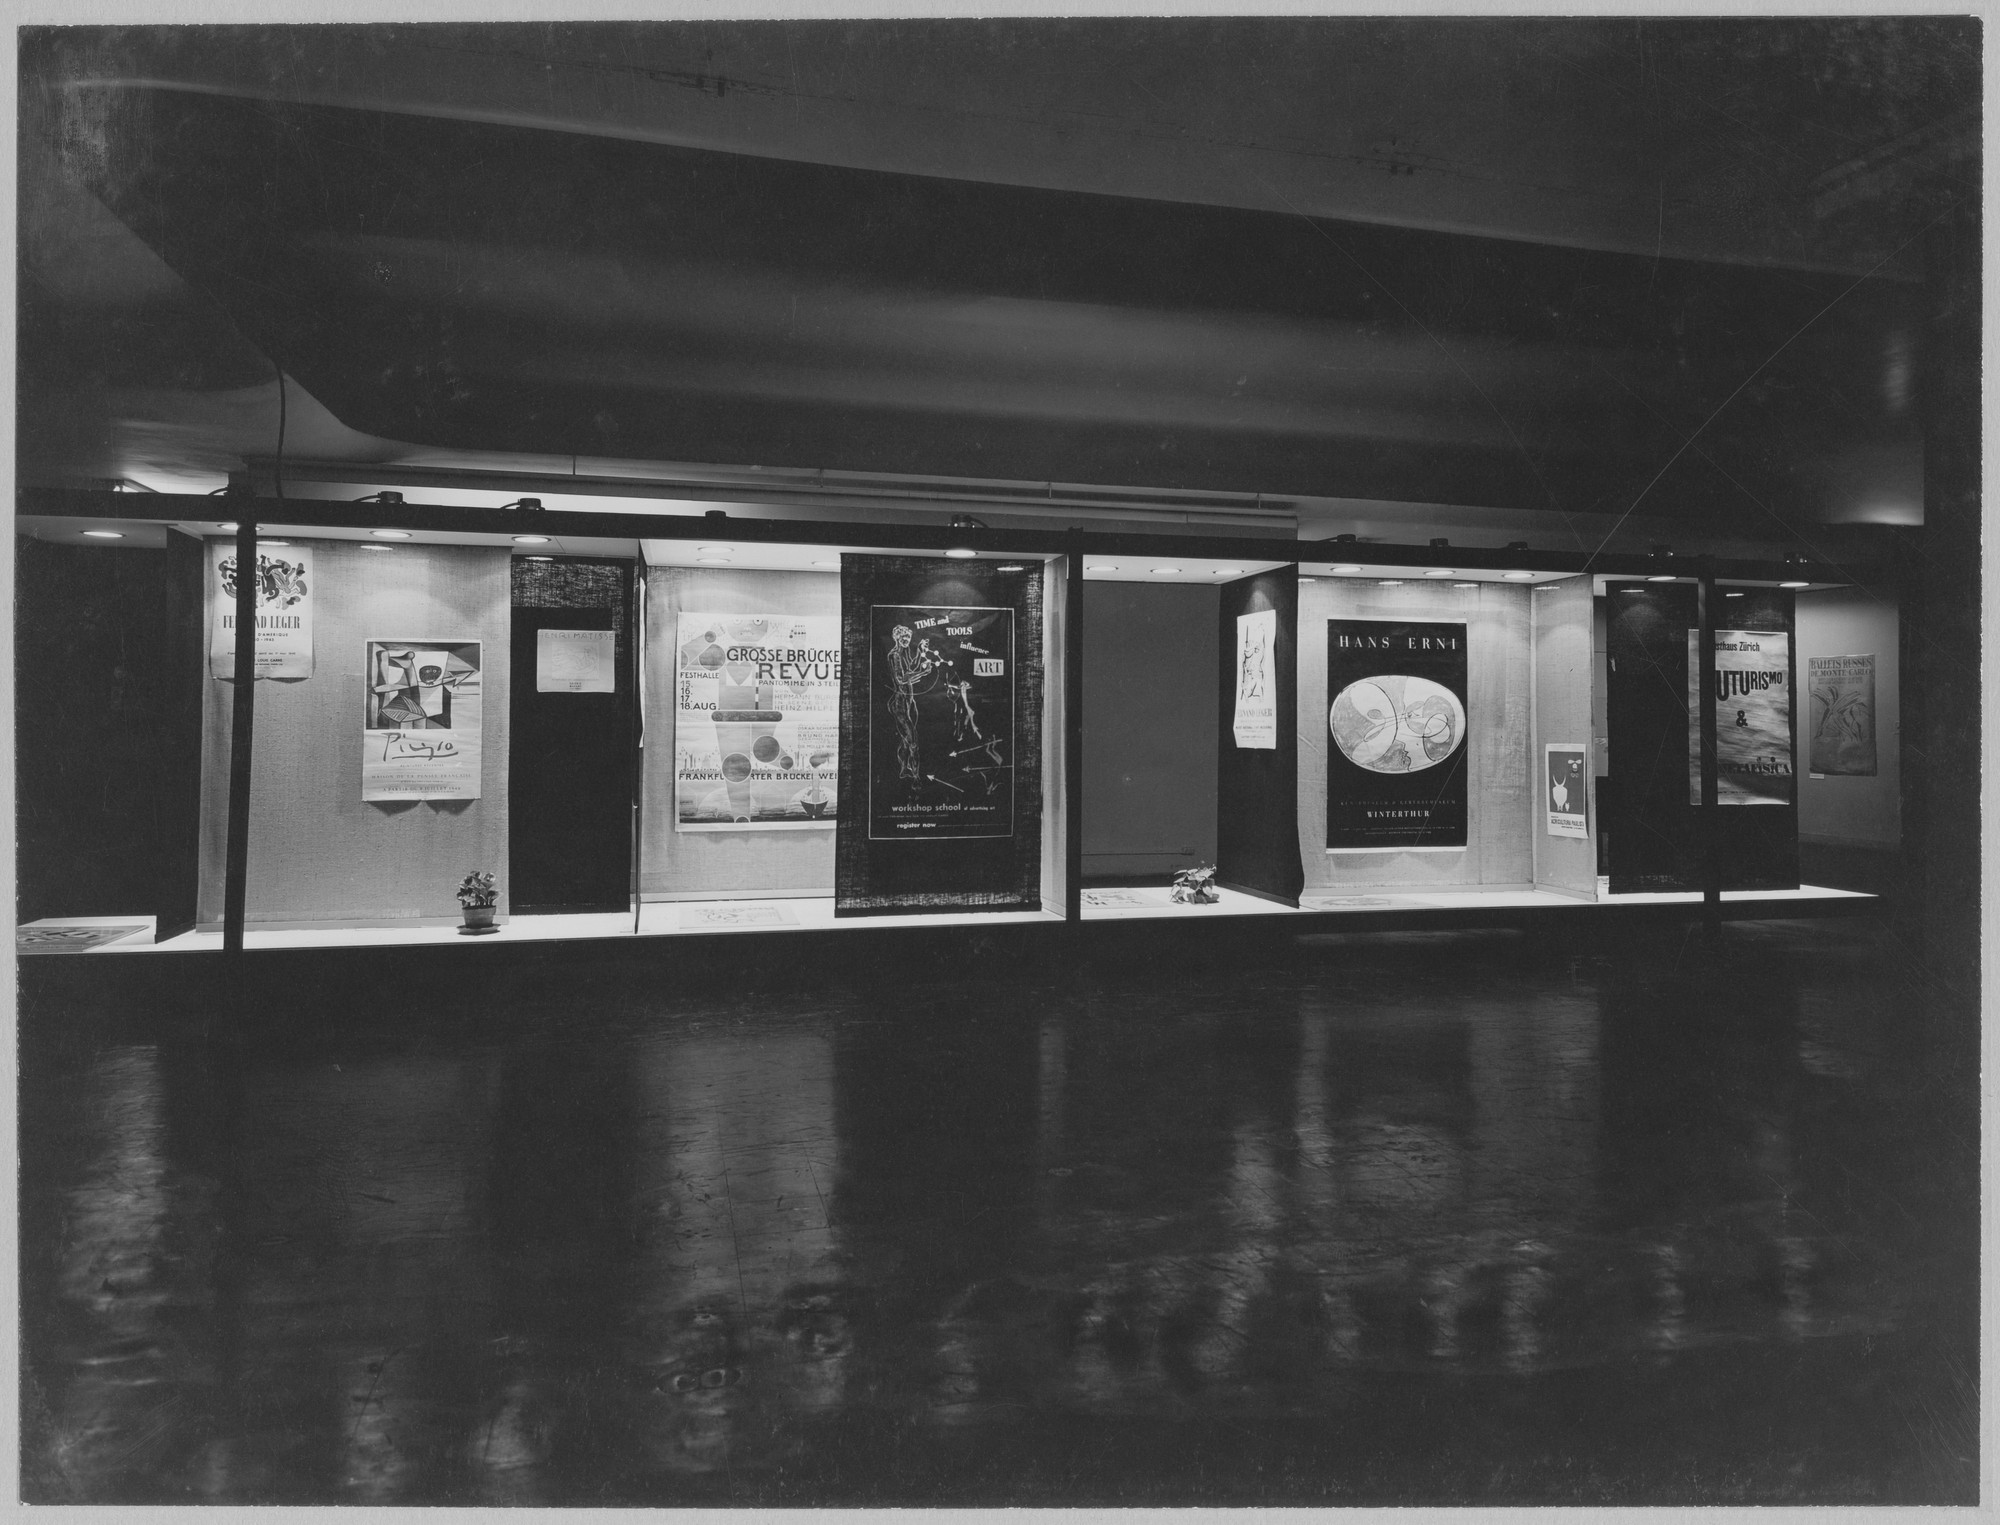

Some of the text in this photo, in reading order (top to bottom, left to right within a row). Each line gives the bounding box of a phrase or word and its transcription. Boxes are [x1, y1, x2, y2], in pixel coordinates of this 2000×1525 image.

[223, 615, 300, 629] FEND LEGER
[914, 615, 950, 629] TIME and
[946, 626, 973, 636] TOOLS
[960, 641, 990, 655] influence
[1339, 635, 1456, 650] HANS ERNI
[1715, 641, 1738, 651] sthaus
[726, 647, 840, 663] GROSSE BRÜCKE
[975, 662, 1002, 674] ART
[1811, 657, 1872, 670] BALLETS RUSSES
[680, 671, 719, 679] FESTHALLE
[758, 662, 841, 680] REVUE
[680, 687, 692, 695] 16.
[1716, 669, 1783, 702] UTURISMO
[680, 694, 692, 702] 17.
[1735, 709, 1748, 728] &
[892, 804, 932, 812] workshop
[935, 803, 961, 812] school
[1366, 810, 1430, 818] WINTERTHUR
